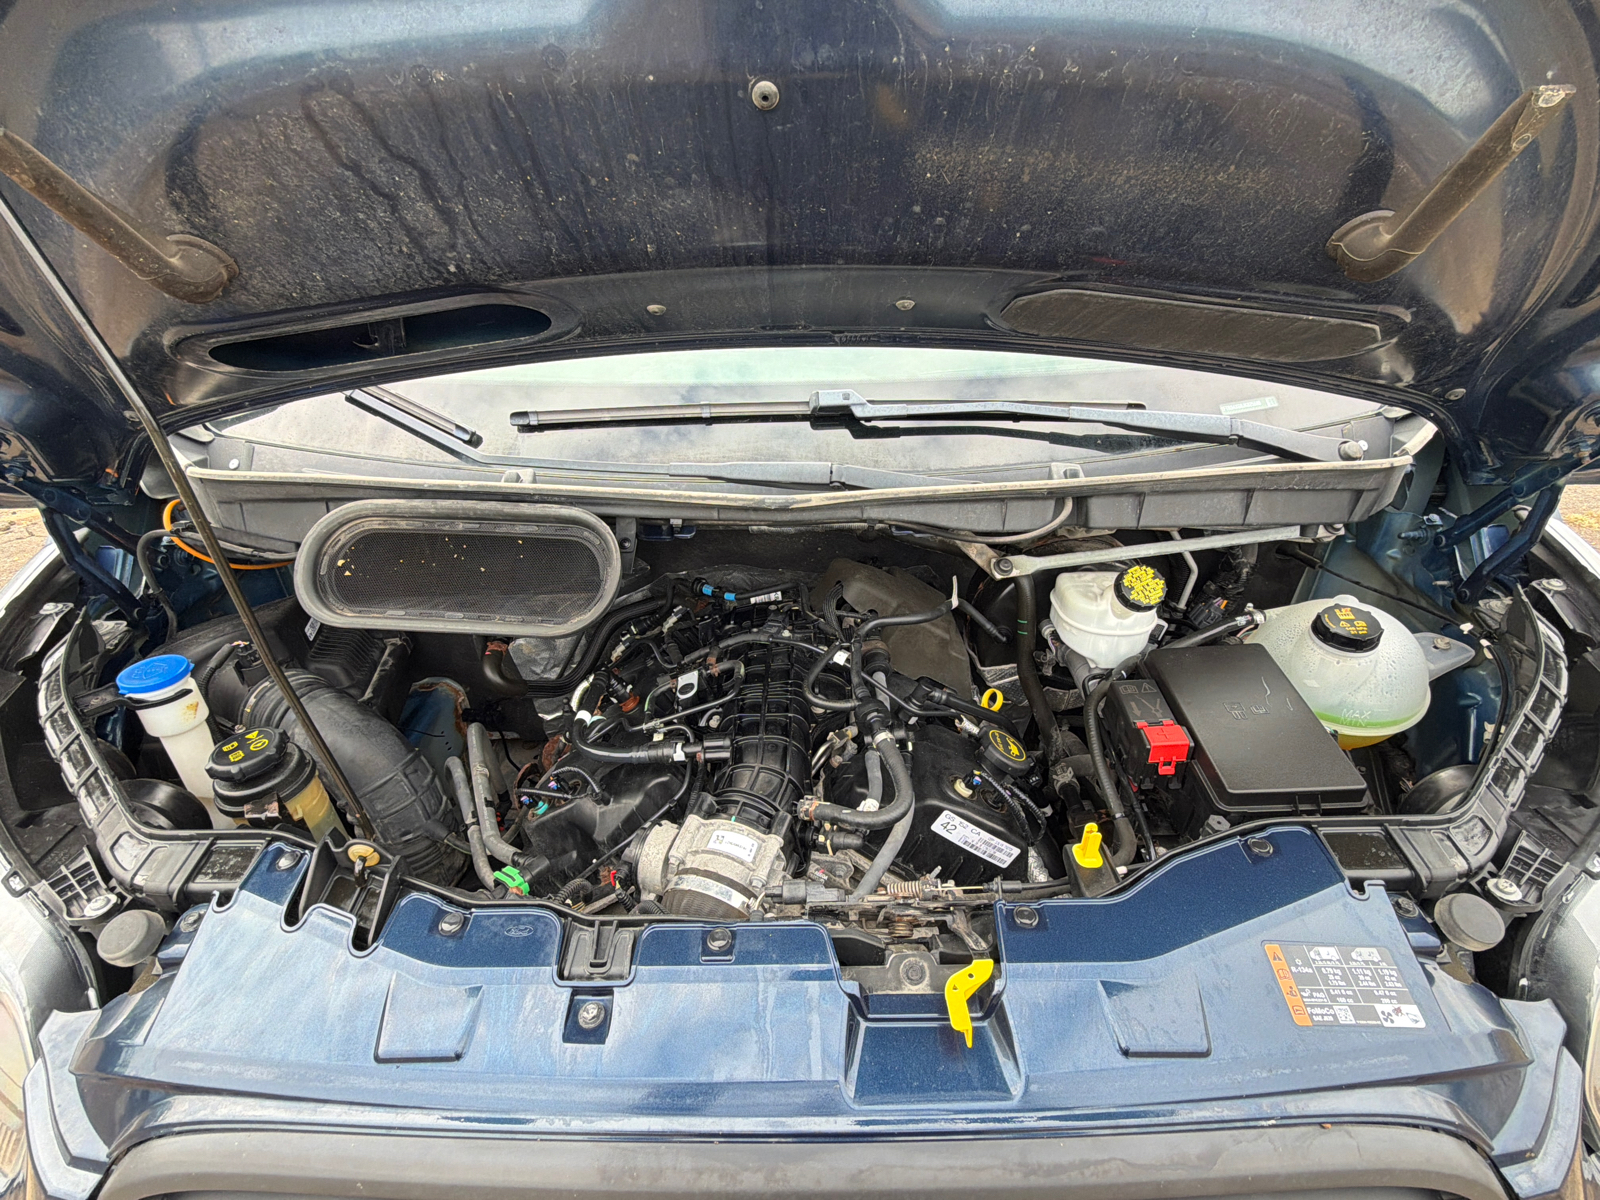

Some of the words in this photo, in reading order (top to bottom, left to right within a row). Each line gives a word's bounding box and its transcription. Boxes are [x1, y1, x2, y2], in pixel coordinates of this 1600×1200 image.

[1341, 708, 1372, 719] MAX
[940, 821, 958, 835] 42
[970, 828, 982, 837] CA
[1307, 1006, 1335, 1015] FoMoCo
